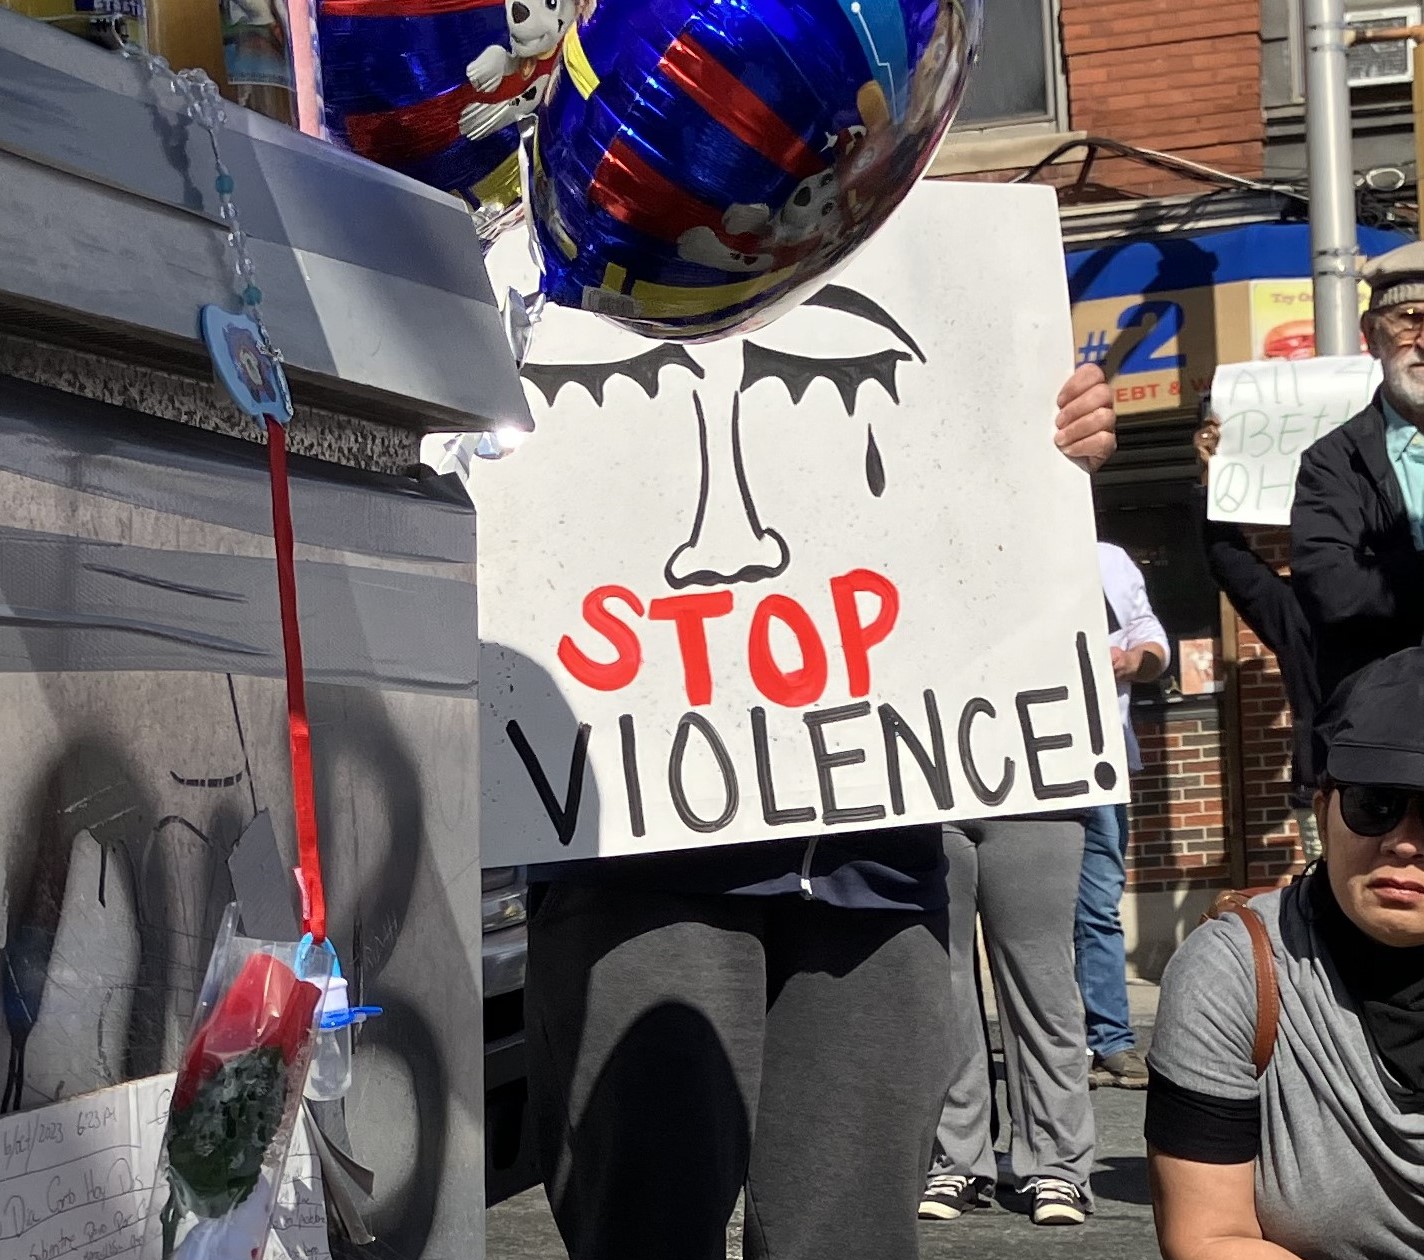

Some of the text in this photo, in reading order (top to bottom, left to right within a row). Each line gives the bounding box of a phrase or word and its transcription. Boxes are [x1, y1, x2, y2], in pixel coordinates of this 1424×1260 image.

[1116, 383, 1160, 402] EBT
[557, 568, 900, 707] STOP
[506, 631, 1118, 847] VIOLENCE!
